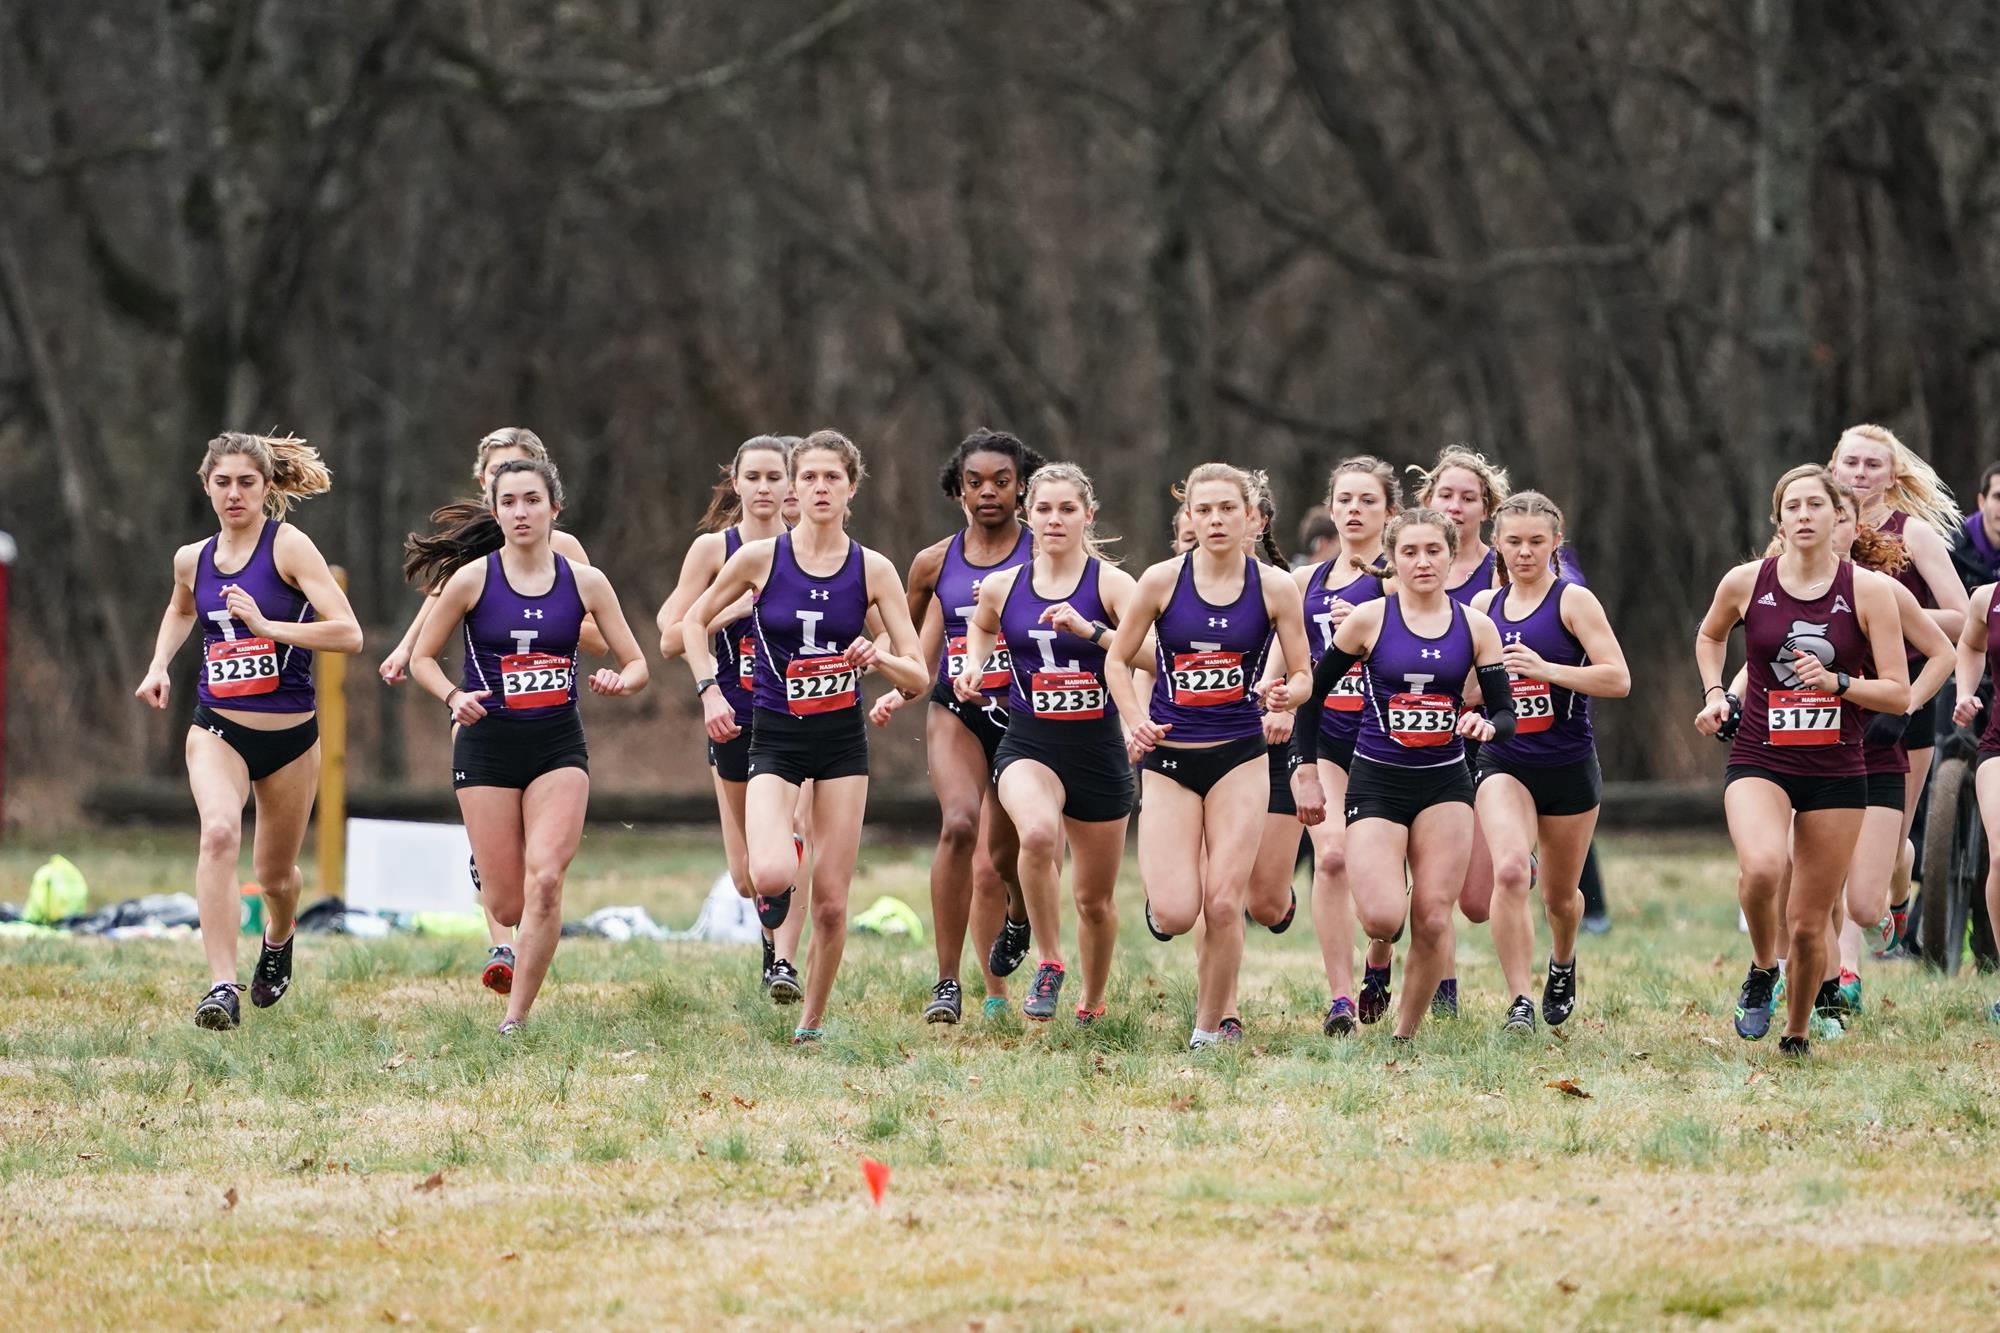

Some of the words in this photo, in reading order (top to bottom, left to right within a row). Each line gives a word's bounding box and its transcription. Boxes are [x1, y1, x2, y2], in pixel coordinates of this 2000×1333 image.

[796, 610, 839, 655] L
[236, 643, 269, 653] NASHVILLE
[211, 655, 275, 682] 3238
[951, 651, 1010, 676] 328
[1480, 664, 1506, 673] ZENS
[506, 669, 566, 693] 3225
[790, 672, 852, 699] 3227
[1175, 667, 1242, 691] 3226
[1513, 684, 1545, 693] NASHVILLE
[1036, 689, 1101, 712] 3233
[1511, 696, 1550, 718] 39
[1392, 710, 1453, 731] 3235
[1771, 707, 1838, 730] 3177
